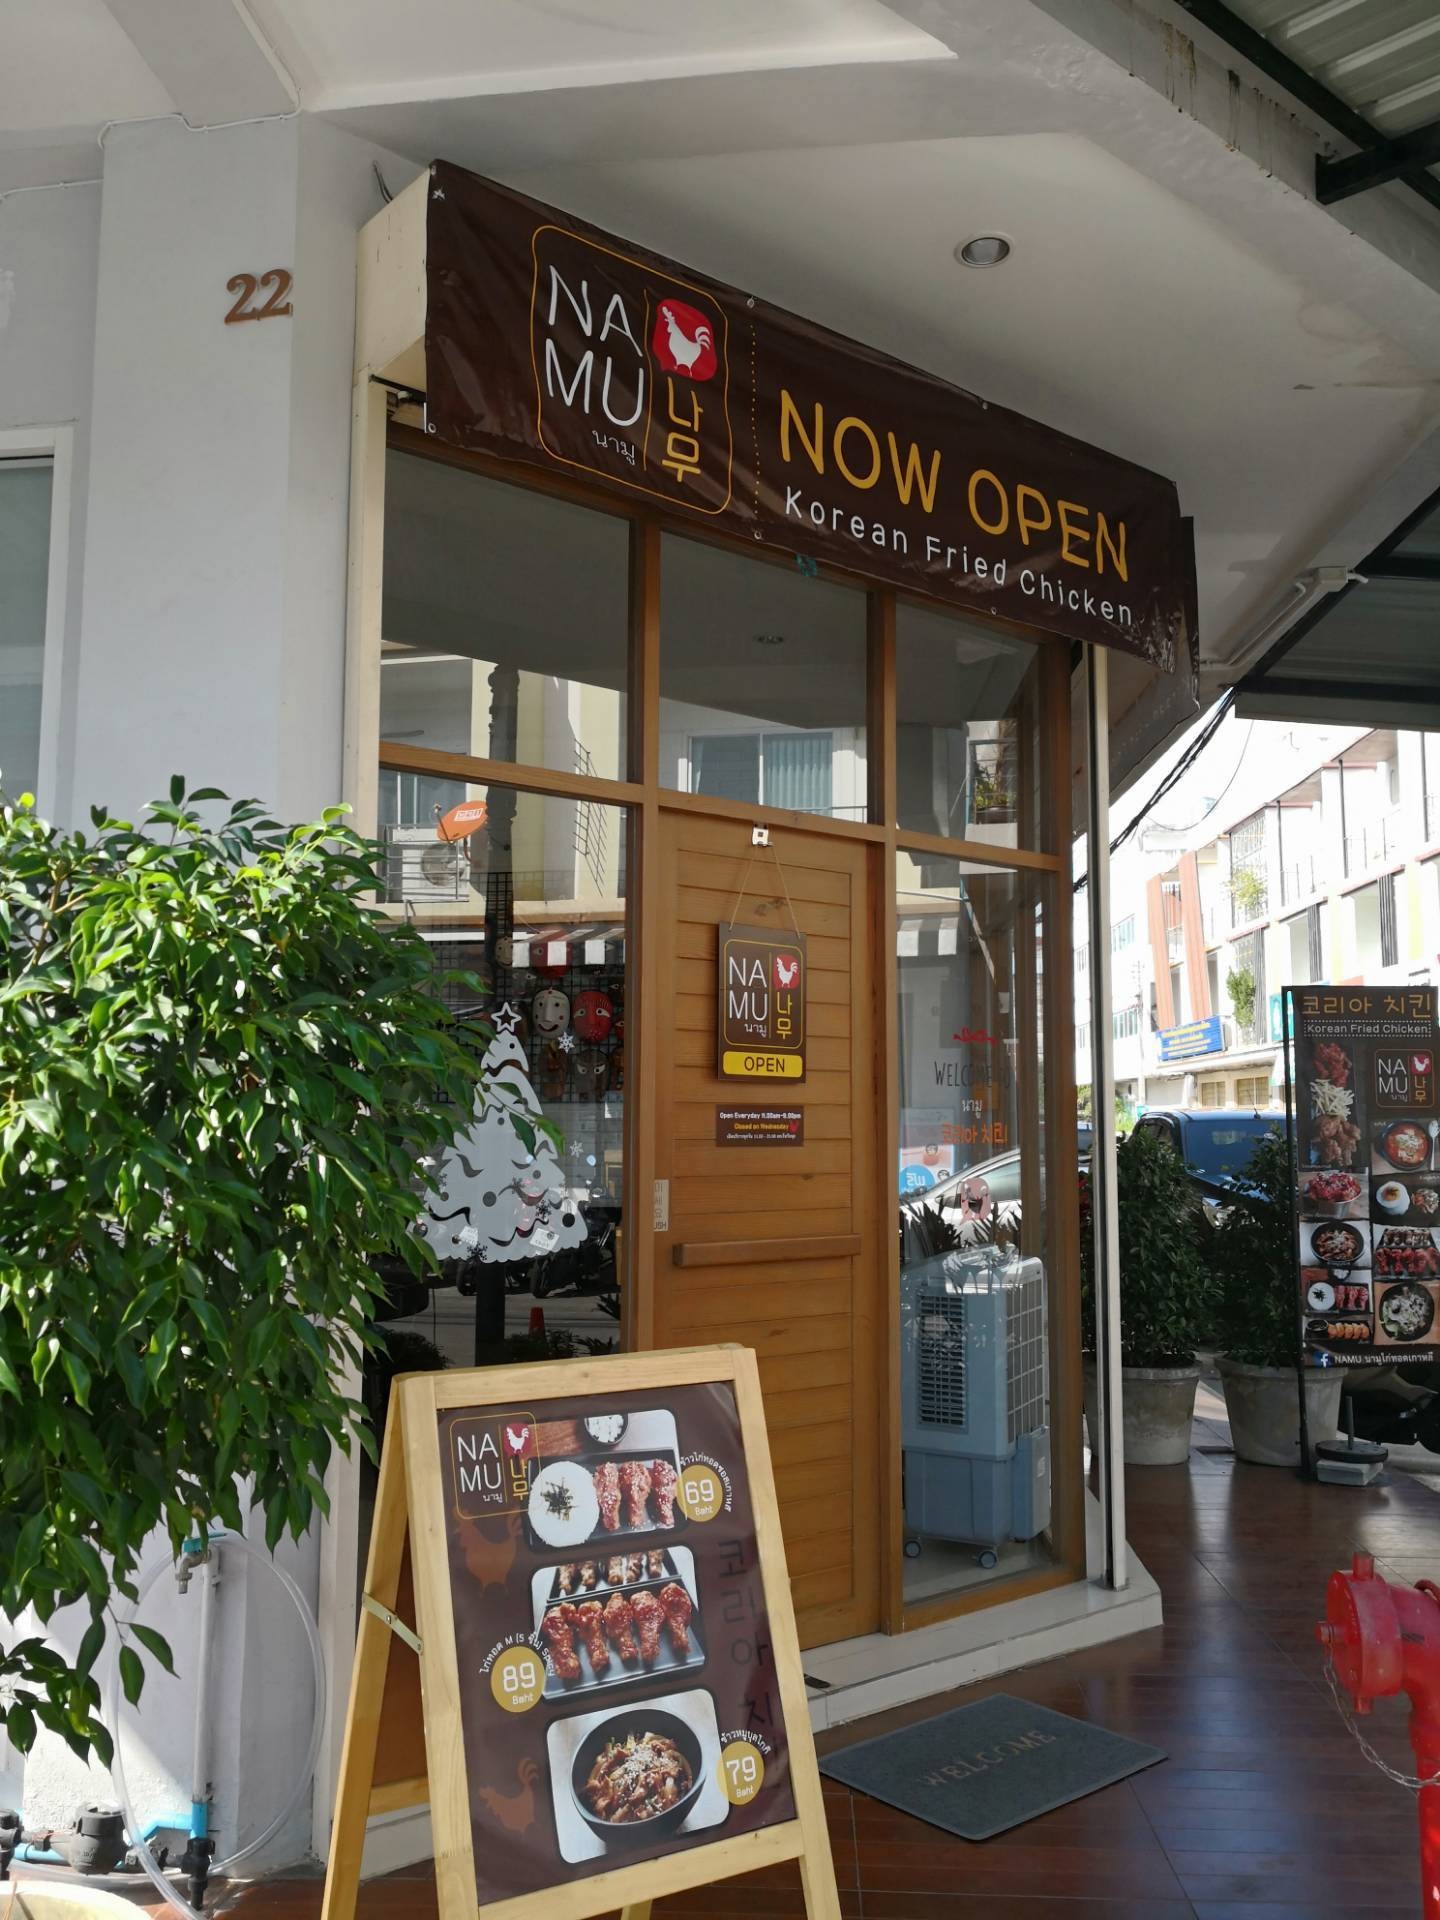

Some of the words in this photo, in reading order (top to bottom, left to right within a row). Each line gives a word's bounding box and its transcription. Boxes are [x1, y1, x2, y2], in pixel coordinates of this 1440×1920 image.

[224, 268, 292, 326] 22
[548, 264, 644, 357] NA
[545, 337, 645, 427] MU
[661, 376, 704, 482] 나무
[592, 429, 636, 466] นามู
[780, 389, 942, 514] NOW
[968, 468, 1129, 582] OPEN
[785, 486, 908, 555] Korean
[926, 535, 1006, 587] Fried
[1020, 569, 1133, 627] Chicken
[729, 956, 767, 988] NA
[729, 990, 768, 1021] MU
[776, 991, 793, 1040] 나무
[1302, 995, 1373, 1014] 코리아
[1384, 993, 1431, 1018] 치킨
[744, 1023, 767, 1038] นามู
[1307, 1024, 1347, 1034] Korean
[1351, 1024, 1380, 1034] Fried
[1382, 1024, 1428, 1034] Chicken
[744, 1056, 785, 1072] OPEN
[1378, 1058, 1407, 1075] NA
[1379, 1076, 1408, 1094] MU
[734, 1112, 760, 1120] Everyday
[962, 1099, 982, 1119] นามู
[1334, 1355, 1361, 1364] NAMU
[458, 1433, 499, 1462] NA
[460, 1462, 501, 1493] MU
[510, 1458, 529, 1501] 나무
[685, 1479, 714, 1504] 69
[696, 1505, 714, 1516] Baht
[478, 1642, 504, 1674] ไก่ทอด
[505, 1635, 514, 1646] M
[503, 1662, 536, 1692] 89
[512, 1692, 534, 1705] Baht
[726, 1756, 756, 1785] 79
[919, 1729, 1057, 1787] WELCOME
[736, 1784, 753, 1798] Baht
